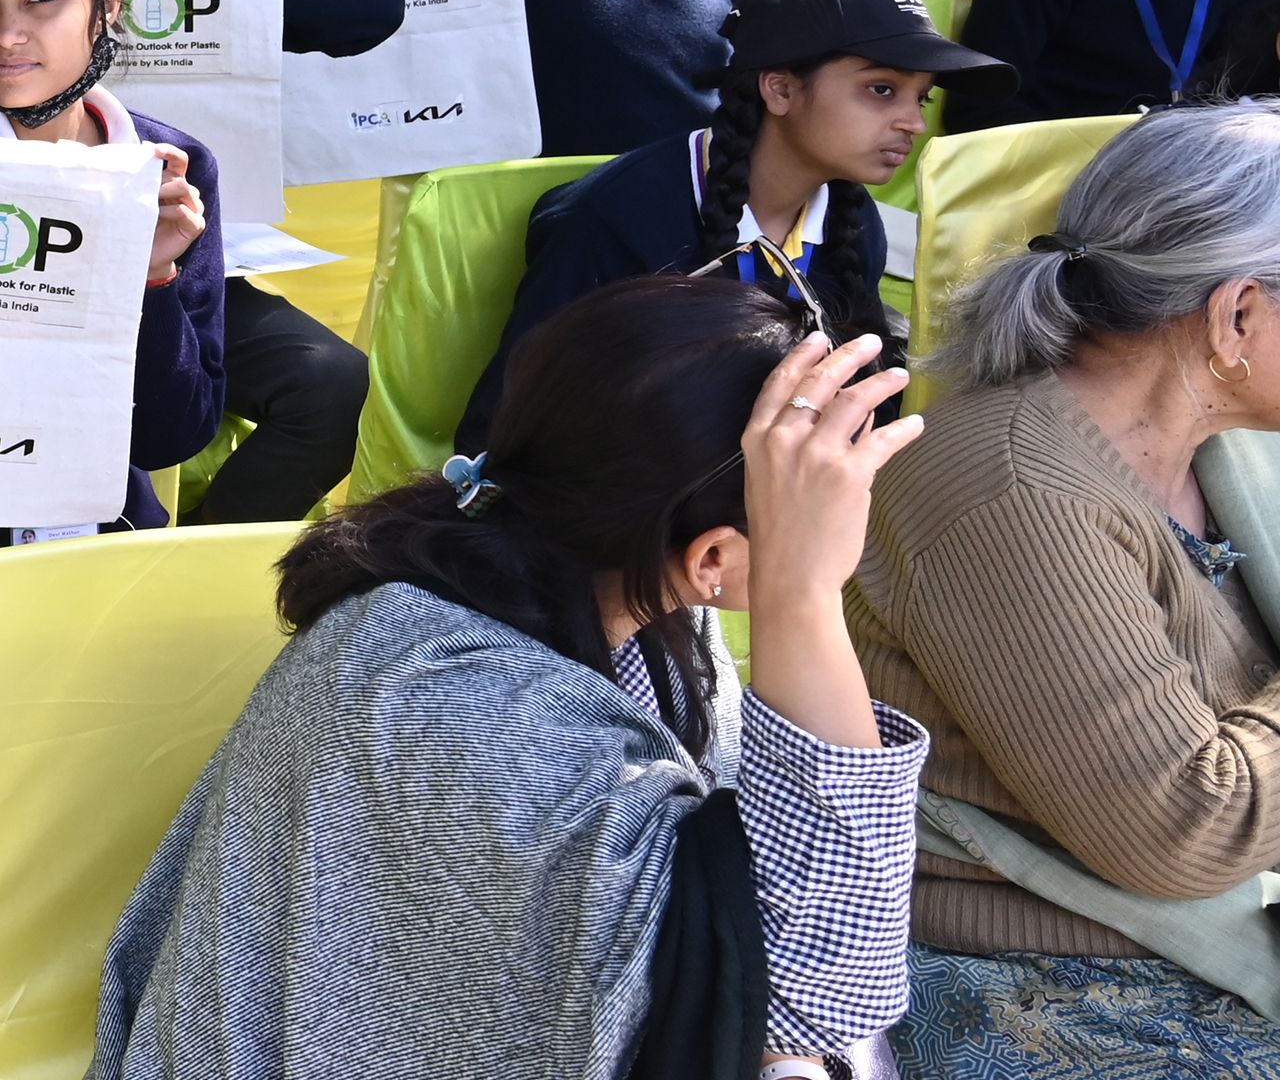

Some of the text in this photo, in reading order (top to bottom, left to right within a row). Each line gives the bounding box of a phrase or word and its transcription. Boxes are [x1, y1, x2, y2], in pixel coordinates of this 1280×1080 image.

[19, 280, 37, 292] for
[38, 282, 76, 297] Plastic
[11, 300, 39, 313] India
